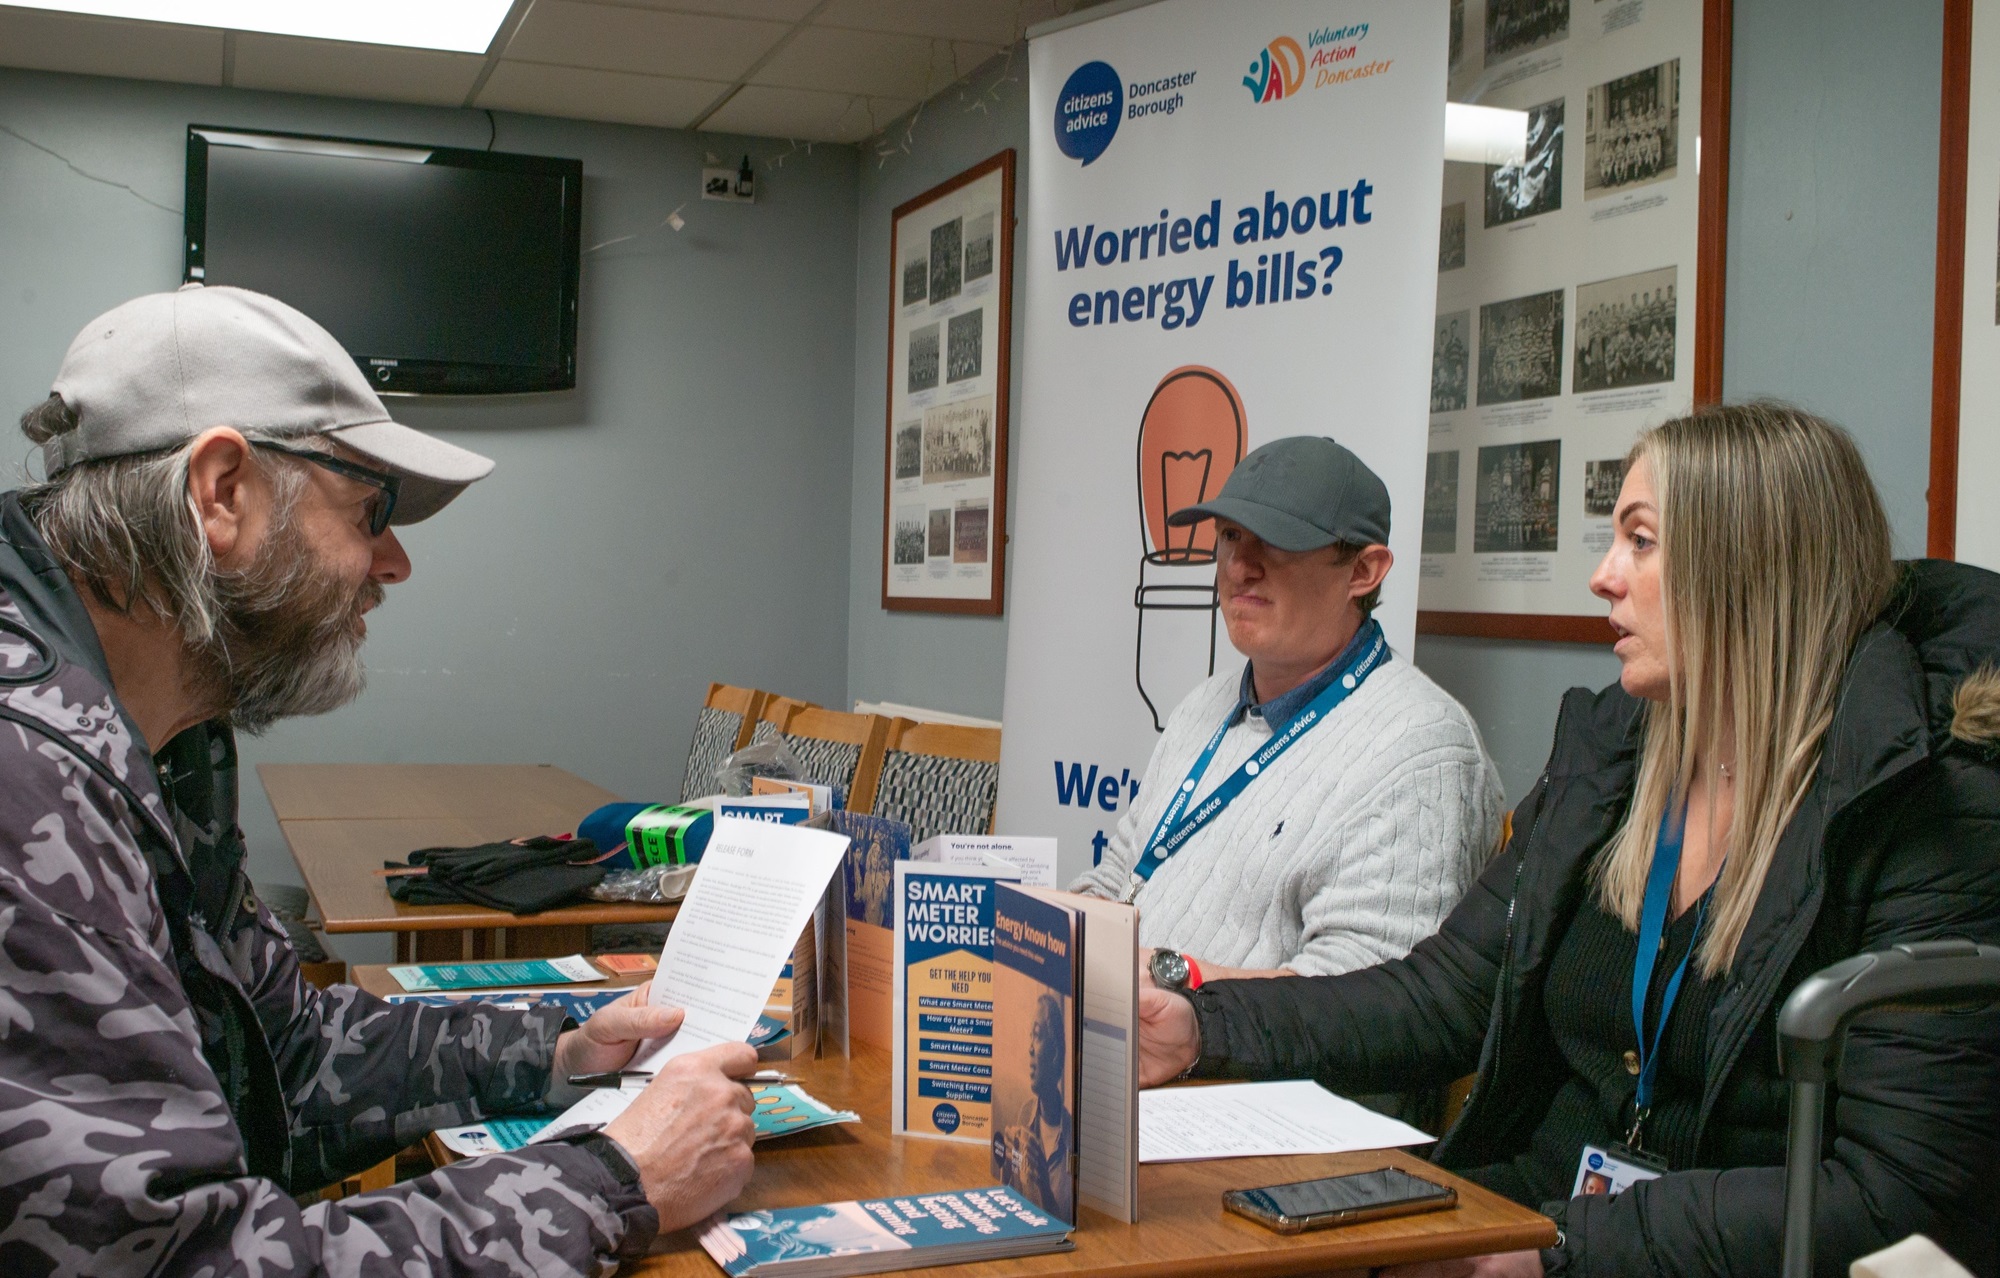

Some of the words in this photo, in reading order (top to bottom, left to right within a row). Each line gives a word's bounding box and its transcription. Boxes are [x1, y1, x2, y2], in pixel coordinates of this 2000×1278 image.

[1308, 23, 1369, 49] Voluntary
[1310, 45, 1357, 69] Action
[1129, 71, 1197, 99] Doncaster
[1315, 59, 1394, 89] Doncaster
[1064, 91, 1113, 114] citizens
[1128, 93, 1184, 120] Borough
[1066, 111, 1108, 133] advice
[1054, 199, 1221, 272] Worried
[1232, 179, 1373, 244] about
[1068, 275, 1215, 330] energy
[1225, 246, 1343, 309] bills?
[1258, 733, 1290, 765] citizens
[1288, 709, 1317, 737] advice
[1054, 760, 1142, 813] We'r
[1164, 791, 1187, 826] citizens
[1166, 820, 1197, 849] citizens
[1194, 796, 1222, 824] advice
[737, 848, 754, 858] FORM
[950, 842, 975, 850] You're
[991, 843, 1014, 851] alone.
[908, 880, 987, 904] SMART
[907, 901, 979, 925] METER
[996, 909, 1024, 943] Energy
[1024, 920, 1048, 949] know
[1047, 931, 1067, 958] how
[929, 968, 942, 980] GET
[944, 969, 957, 981] THE
[958, 970, 976, 981] HELP
[978, 972, 992, 984] YOU
[951, 982, 970, 993] NEED
[919, 998, 939, 1006] What
[952, 1000, 973, 1009] Smart
[926, 1014, 943, 1022] How
[957, 1018, 969, 1026] get
[975, 1019, 994, 1027] Smar
[949, 1026, 974, 1035] Meter?
[930, 1041, 951, 1051] Smart
[951, 1043, 973, 1053] Meter
[974, 1046, 992, 1055] Pros.
[929, 1062, 950, 1071] Smart
[950, 1063, 972, 1073] Meter
[972, 1066, 992, 1075] Cons.
[931, 1080, 965, 1092] Switching
[965, 1083, 989, 1095] Energy
[945, 1090, 975, 1101] Supplier
[893, 1199, 929, 1219] and
[917, 1196, 966, 1230] betting
[963, 1191, 1008, 1219] about
[986, 1188, 1023, 1212] Let's
[1014, 1208, 1049, 1228] talk
[864, 1201, 918, 1236] gaming
